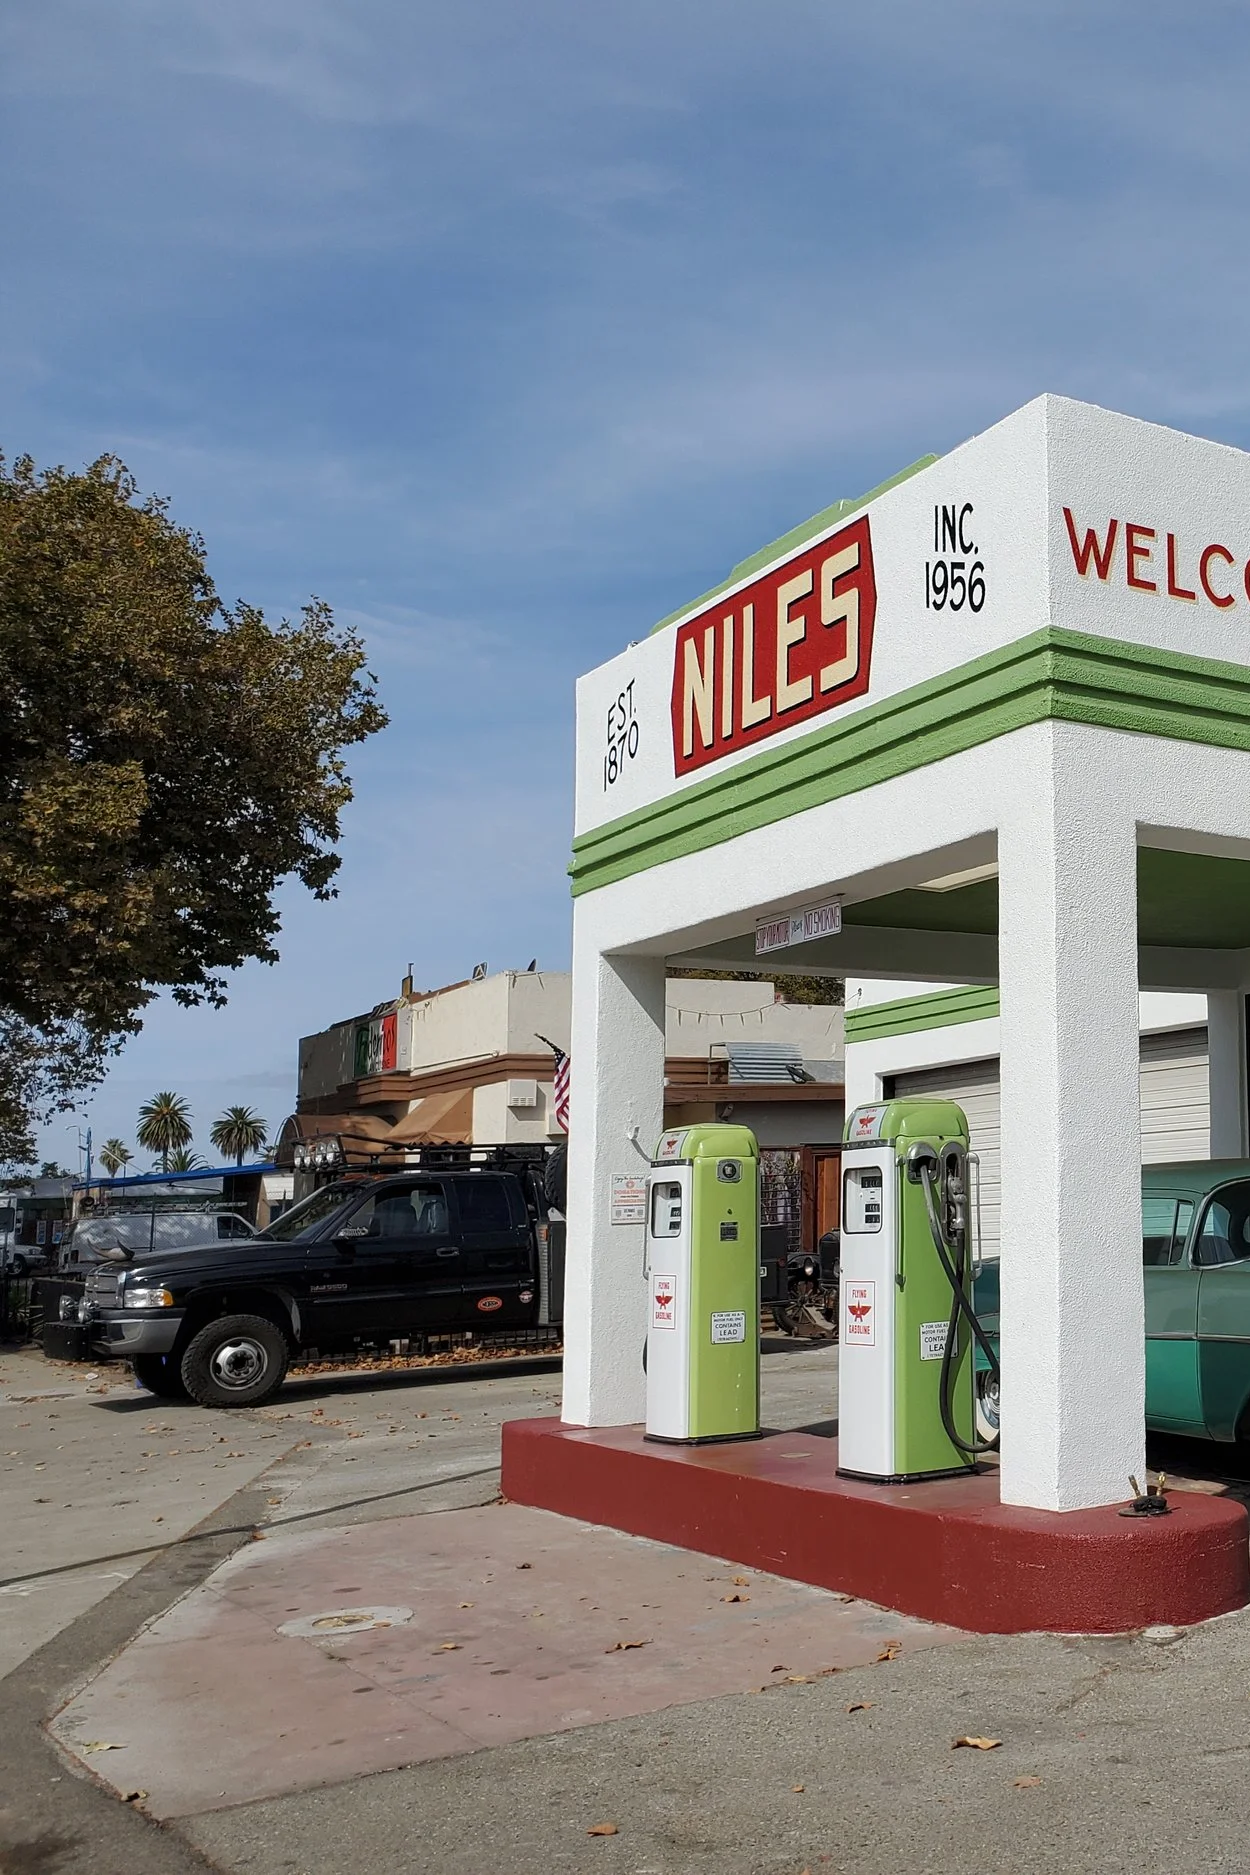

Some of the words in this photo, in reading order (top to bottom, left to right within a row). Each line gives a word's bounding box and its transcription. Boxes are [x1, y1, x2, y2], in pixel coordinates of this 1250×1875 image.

[934, 502, 979, 554] INC.
[925, 560, 986, 613] 1956
[682, 541, 861, 758] NILES
[607, 678, 638, 746] EST.
[603, 724, 639, 792] 1870
[655, 1312, 672, 1320] GASOLINE
[852, 1289, 867, 1298] FLYING
[848, 1324, 871, 1335] GASOLINE
[929, 1343, 945, 1352] LEA
